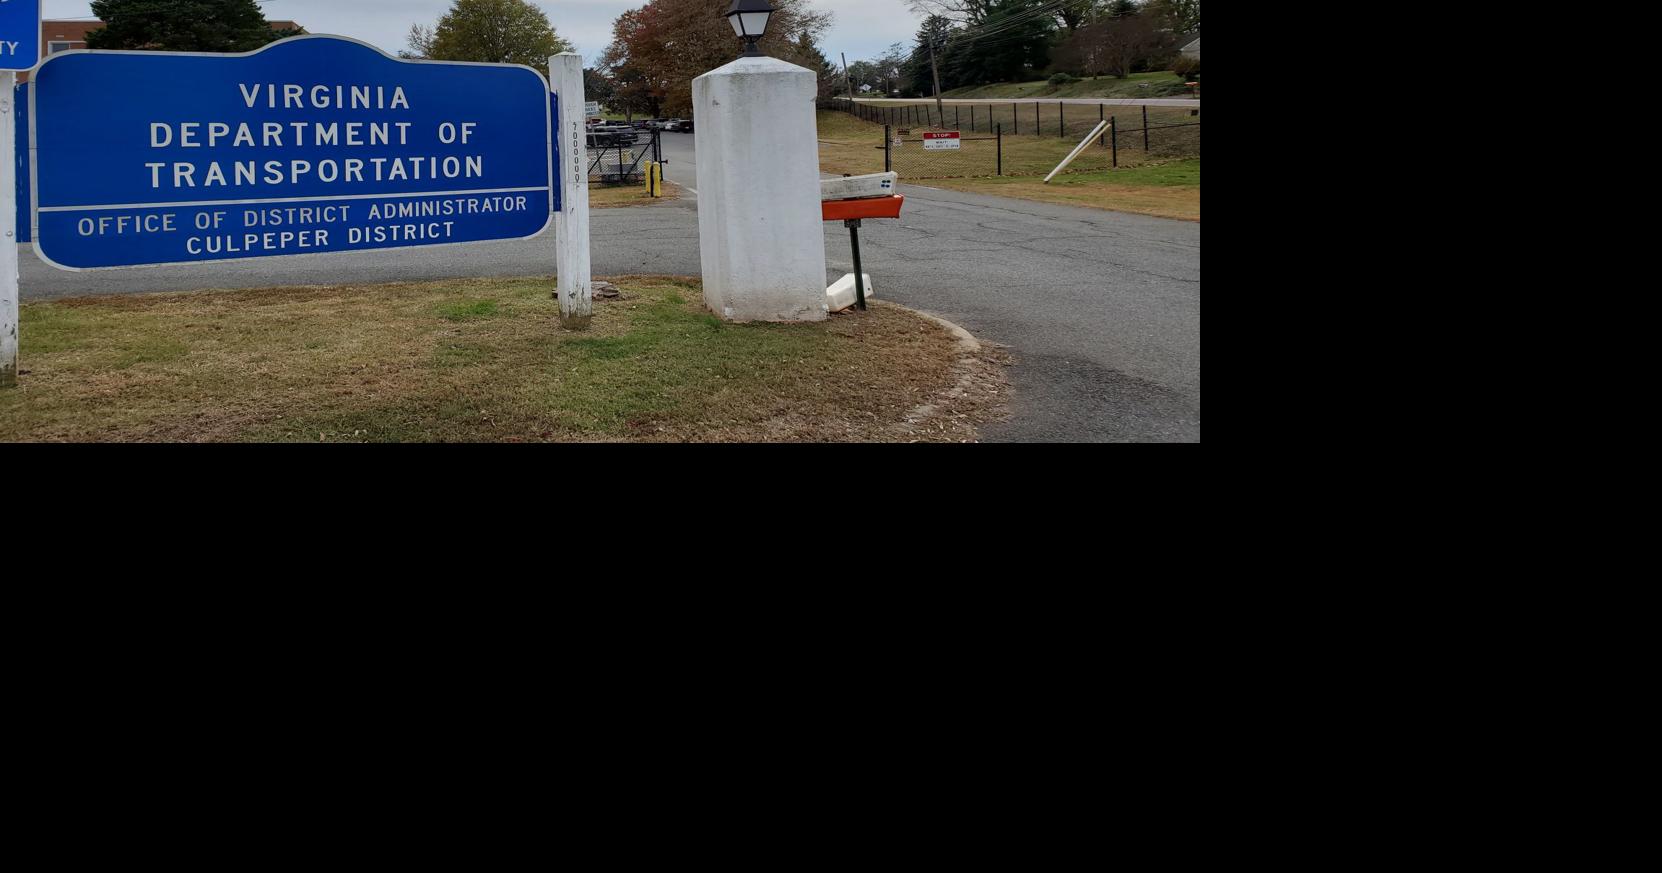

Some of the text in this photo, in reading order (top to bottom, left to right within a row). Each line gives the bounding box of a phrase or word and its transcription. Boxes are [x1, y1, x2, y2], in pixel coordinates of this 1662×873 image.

[238, 83, 410, 109] VIRGINIA
[150, 122, 477, 148] DEPARTMENT OF
[144, 155, 482, 188] TRANSPORTATION
[77, 196, 527, 236] OFFICE OF DISTRICT ADMINISTRATOR
[186, 221, 454, 255] CULPEPER DISTRICT
